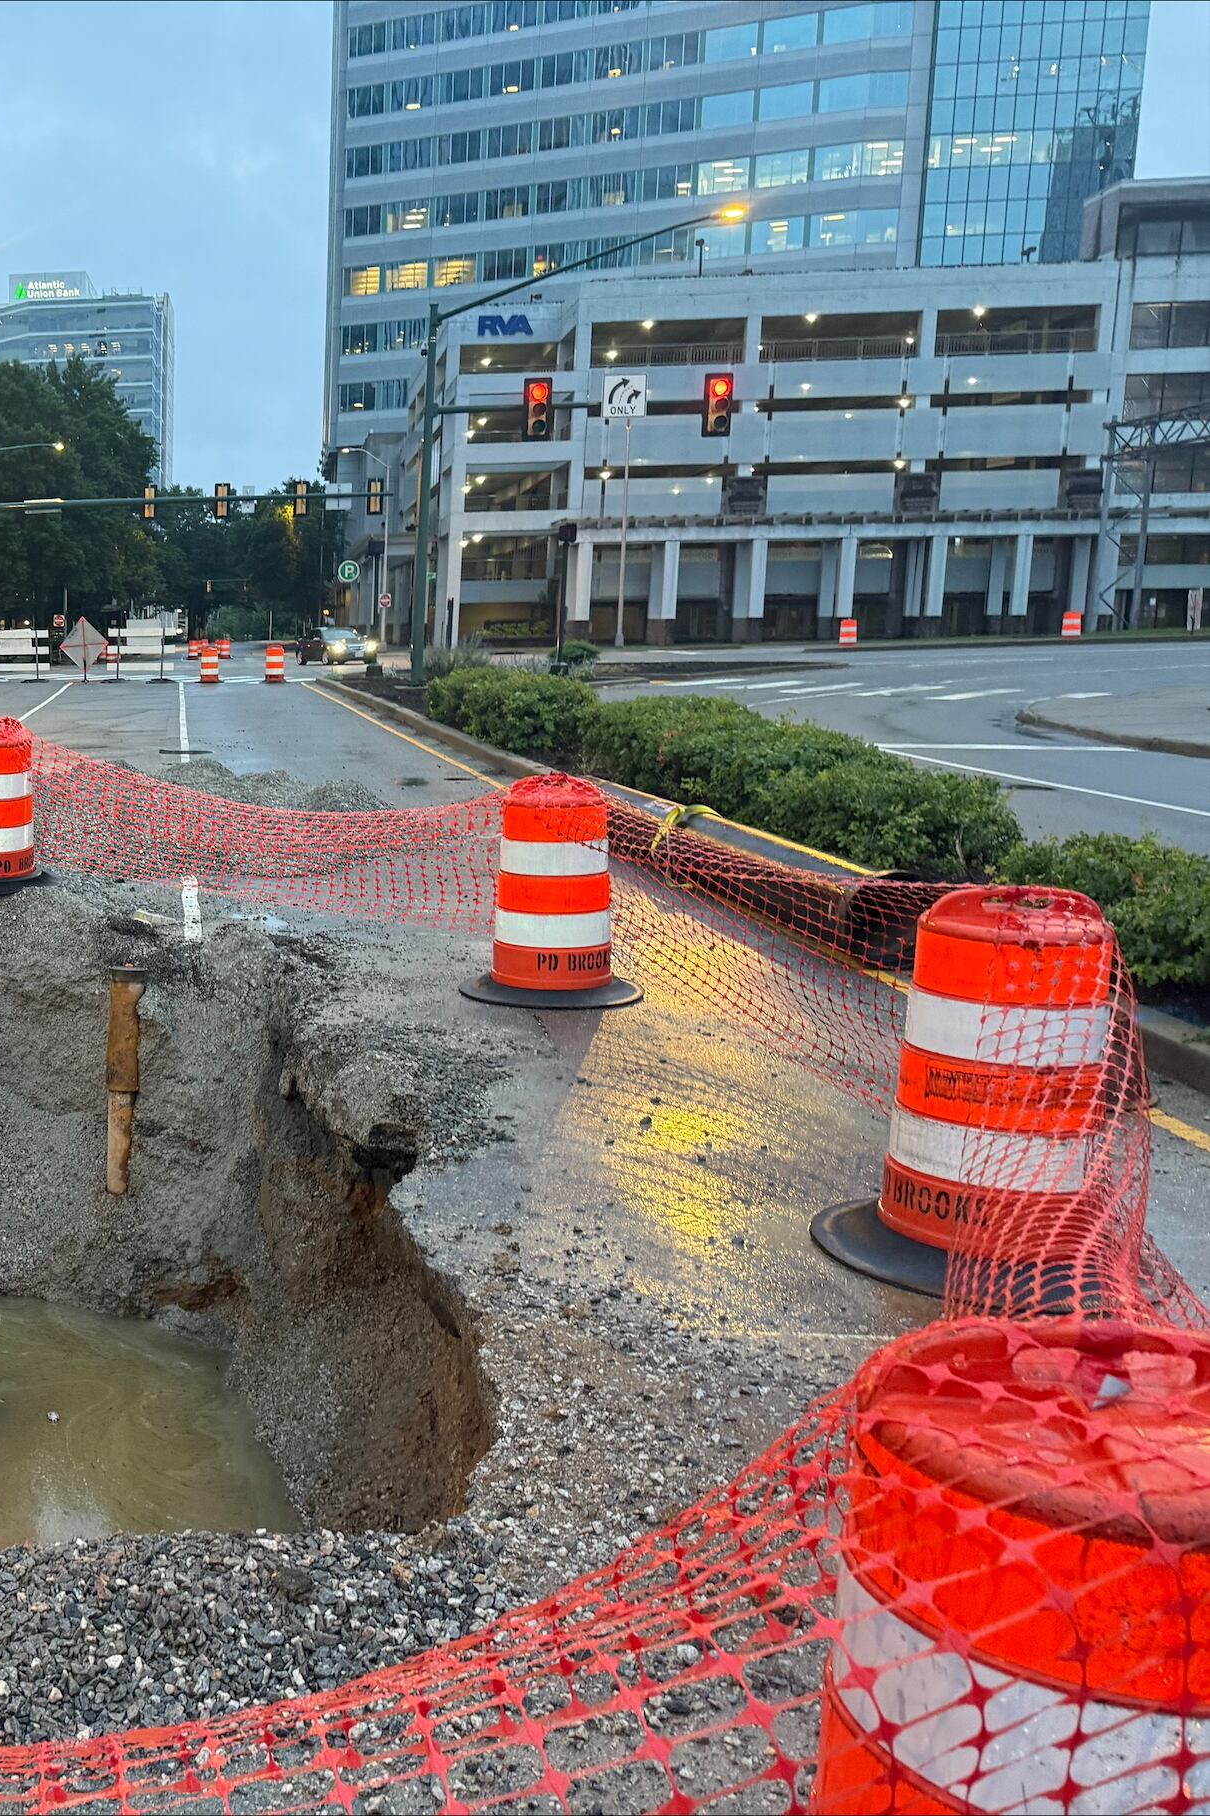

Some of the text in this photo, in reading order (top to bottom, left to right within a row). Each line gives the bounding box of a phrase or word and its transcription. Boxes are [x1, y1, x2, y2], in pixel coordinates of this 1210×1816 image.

[27, 280, 65, 290] Atlantic
[26, 287, 81, 299] Union Bank
[477, 315, 533, 336] RVA
[610, 405, 637, 415] ONLY
[344, 565, 355, 578] P
[537, 953, 559, 971] PD
